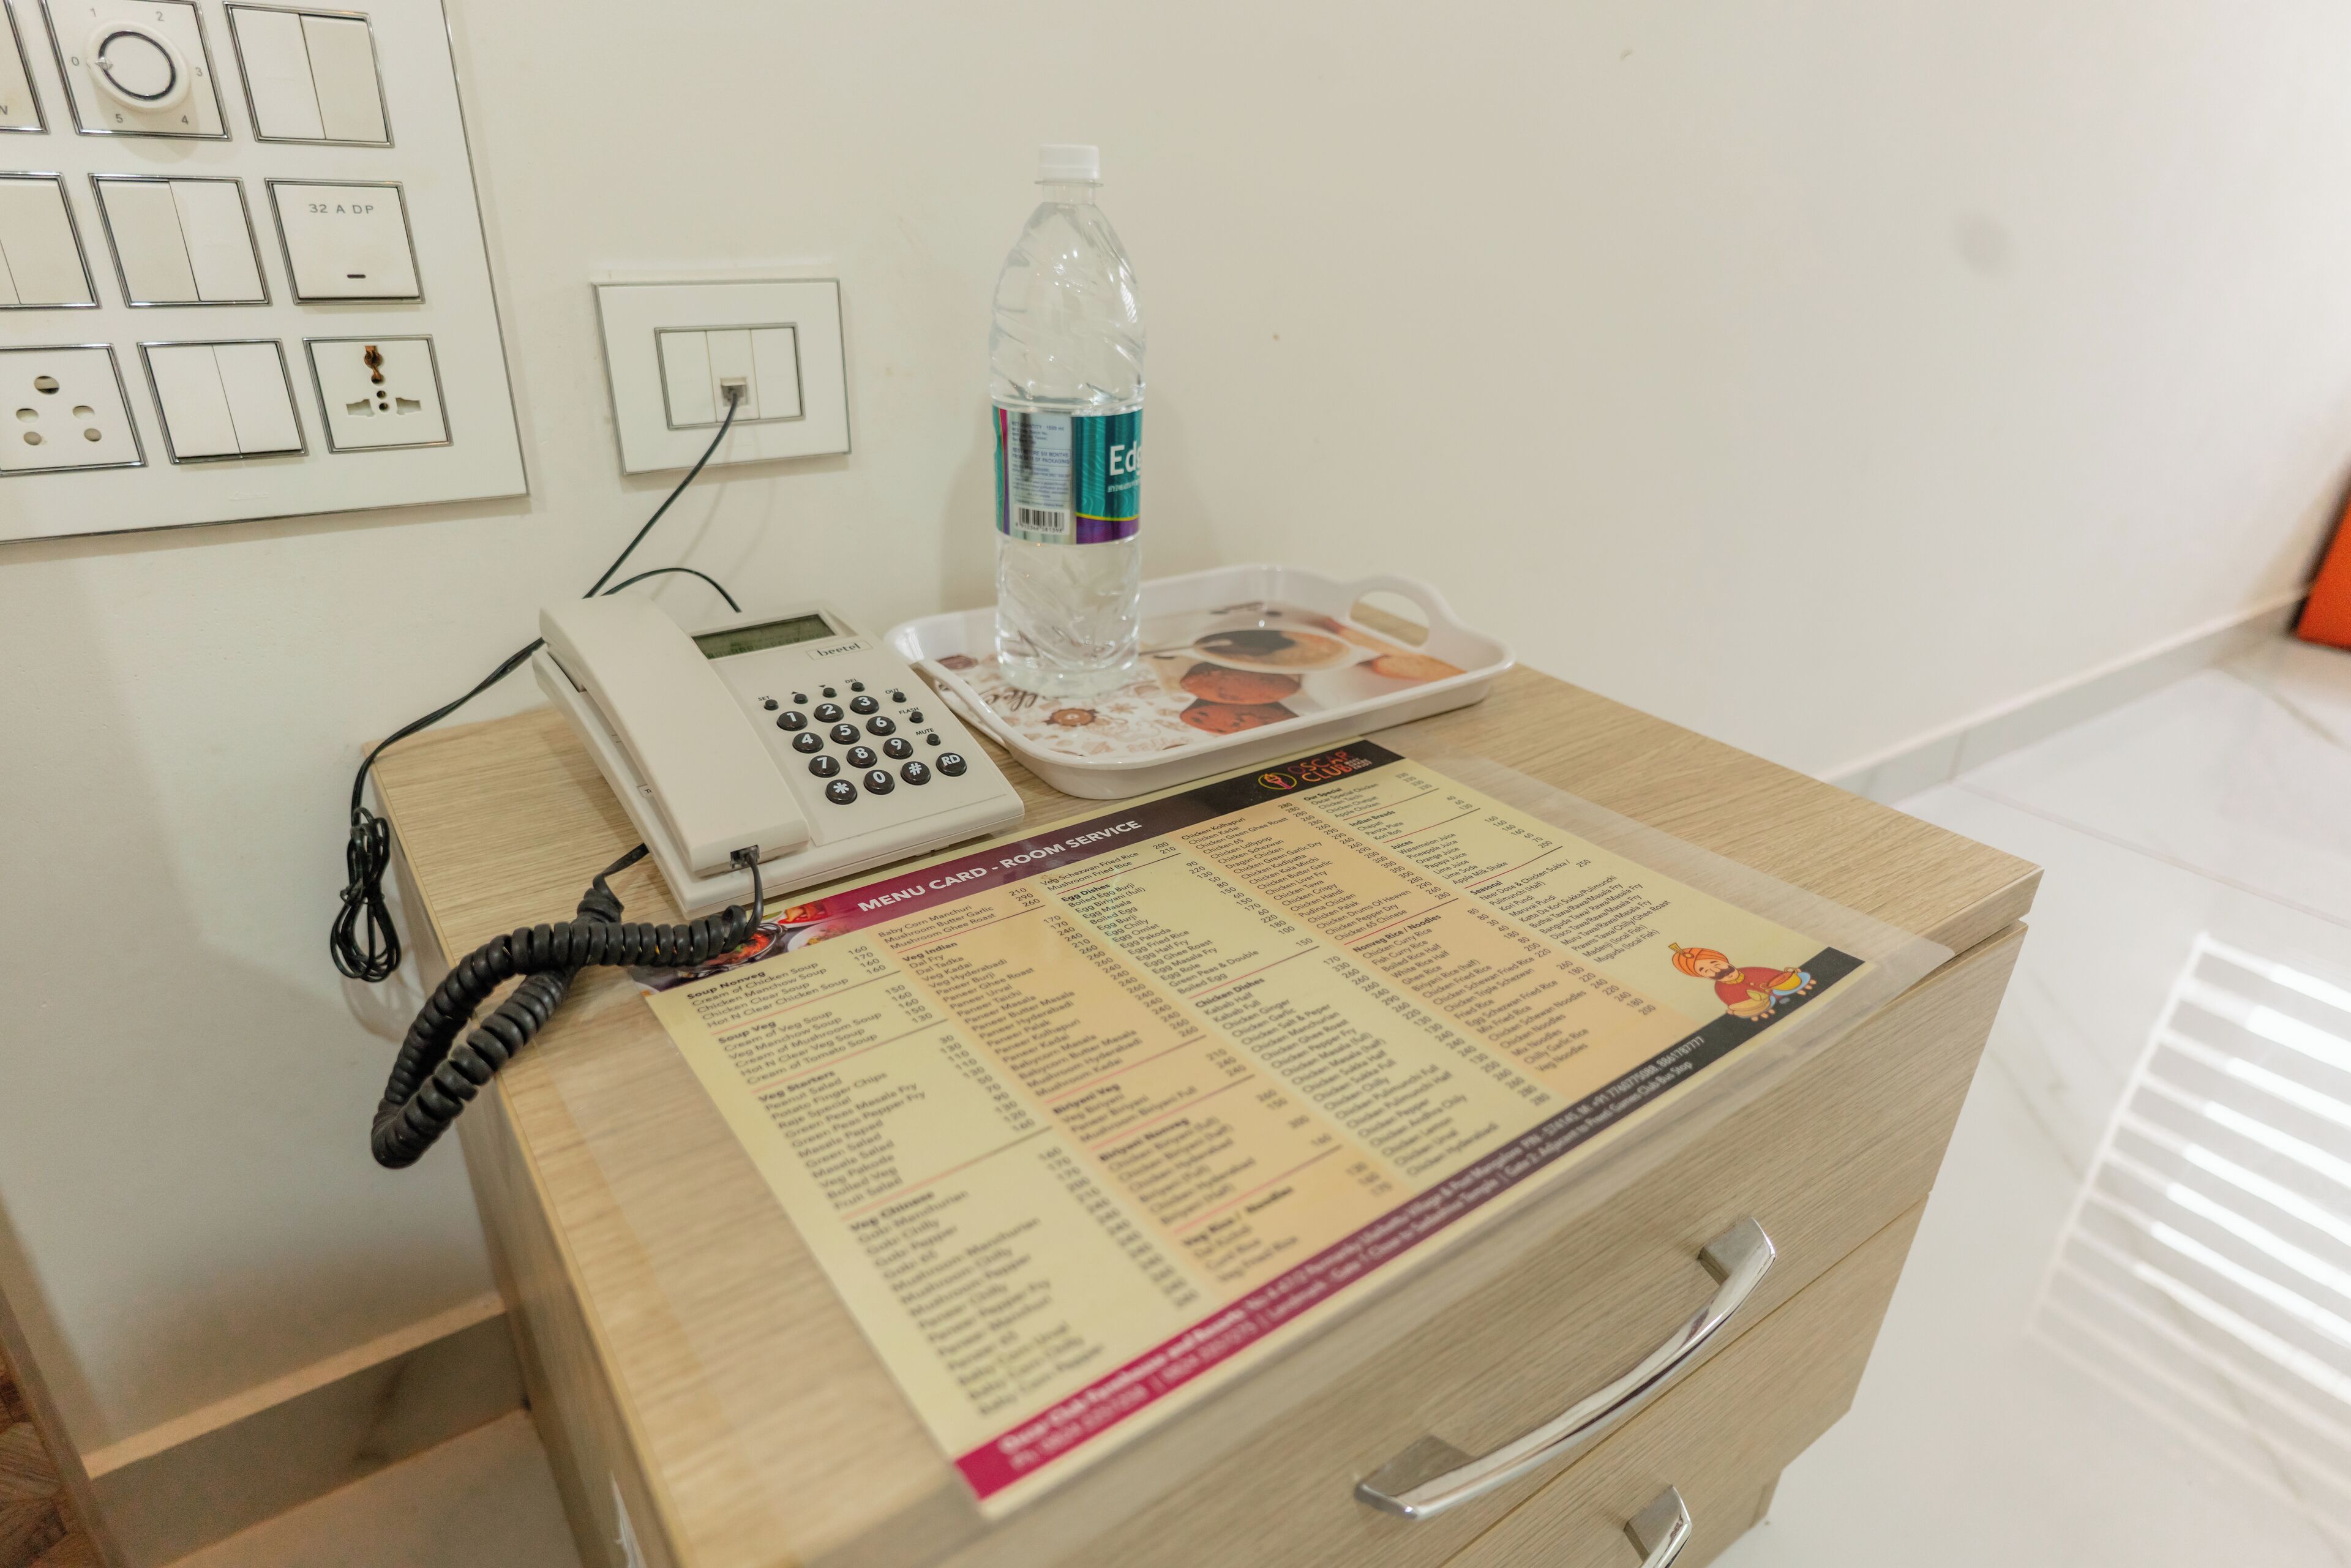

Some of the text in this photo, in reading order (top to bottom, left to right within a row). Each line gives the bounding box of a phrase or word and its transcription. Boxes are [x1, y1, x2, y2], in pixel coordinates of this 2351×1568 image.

[90, 7, 97, 17] 1
[156, 11, 165, 21] 2
[70, 56, 80, 66] 0
[195, 67, 203, 77] 3
[115, 113, 124, 123] 5
[181, 114, 189, 125] 4
[308, 203, 374, 214] 32 A DP
[816, 642, 861, 657] beetel
[822, 705, 836, 715] 2
[858, 697, 871, 706] 3
[899, 707, 920, 715] FLASH
[787, 712, 797, 722] 1
[876, 717, 887, 727] 6
[801, 733, 814, 744] 4
[839, 725, 852, 735] 5
[855, 748, 868, 759] 8
[890, 739, 902, 750] 9
[817, 757, 828, 769] 7
[909, 762, 922, 776] #
[941, 754, 961, 766] RD
[872, 771, 886, 784] 0
[1301, 763, 1352, 782] CLUB
[1209, 847, 1242, 859] Chicken
[1239, 836, 1272, 849] Lollypop
[1217, 852, 1249, 864] Chicken
[1247, 839, 1284, 854] Schezwan
[1390, 840, 1414, 850] Juices
[1224, 857, 1255, 869] Dragon
[1253, 847, 1284, 859] Chicken
[1415, 853, 1443, 864] Orange
[1441, 847, 1460, 855] Juice
[857, 885, 926, 912] MENU
[929, 868, 988, 890] CARD
[999, 844, 1066, 868] ROOM
[1065, 820, 1142, 848] SERVICE
[1057, 865, 1100, 880] Schezwan
[1098, 857, 1122, 867] Fried
[1119, 852, 1139, 860] Rice
[1074, 865, 1205, 913] Egg Biriyani (full) 220
[1469, 879, 1503, 895] Seasonal
[1478, 891, 1499, 901] Neer
[1520, 870, 1549, 883] Chicken
[1545, 861, 1567, 872] Sukka
[1488, 858, 1591, 906] Pulimunchi (Half) 250
[1060, 883, 1111, 902] Egg Dishes
[1067, 895, 1097, 907] Boiled
[1095, 890, 1116, 898] Egg
[1114, 882, 1135, 892] Burji
[877, 887, 1027, 937] Baby Corn Manchuri 210
[1103, 886, 1237, 937] Egg Chilly 150
[1316, 915, 1349, 929] Chicken
[1346, 904, 1374, 917] Drums
[1381, 890, 1411, 902] Heaven
[1415, 880, 1433, 890] 290
[1498, 894, 1535, 912] Kori Pundi
[1507, 894, 1558, 917] Maruvai Pundi
[883, 892, 1033, 943] Mushroom Butter Garlic 290
[889, 898, 1040, 950] Mushroom Ghee Roast 260
[1570, 899, 1671, 951] Prawns Tawa/Chilly/Ghee Roast
[908, 914, 1062, 969] Dal Fry 170
[1351, 937, 1388, 953] Nonveg
[1384, 930, 1404, 940] Rice
[1406, 914, 1442, 930] Noodles
[901, 942, 958, 962] Veg Indian
[1592, 928, 1660, 963] Mugudu (local Fish)
[686, 971, 766, 1000] Soup Nonveg
[691, 945, 868, 1007] Cream of Chicken Soup 160
[696, 951, 874, 1013] Chicken Manchow Soup 170
[701, 957, 880, 1020] Chicken Clear Soup 160
[1194, 977, 1265, 1008] Chicken Dishes
[718, 1021, 777, 1044] Soup Veg
[728, 991, 912, 1060] Veg Manchow Soup 160
[1609, 1092, 1642, 1113] Games
[1637, 1081, 1660, 1096] Club
[1655, 1072, 1675, 1085] Bus
[1670, 1061, 1693, 1075] Stop
